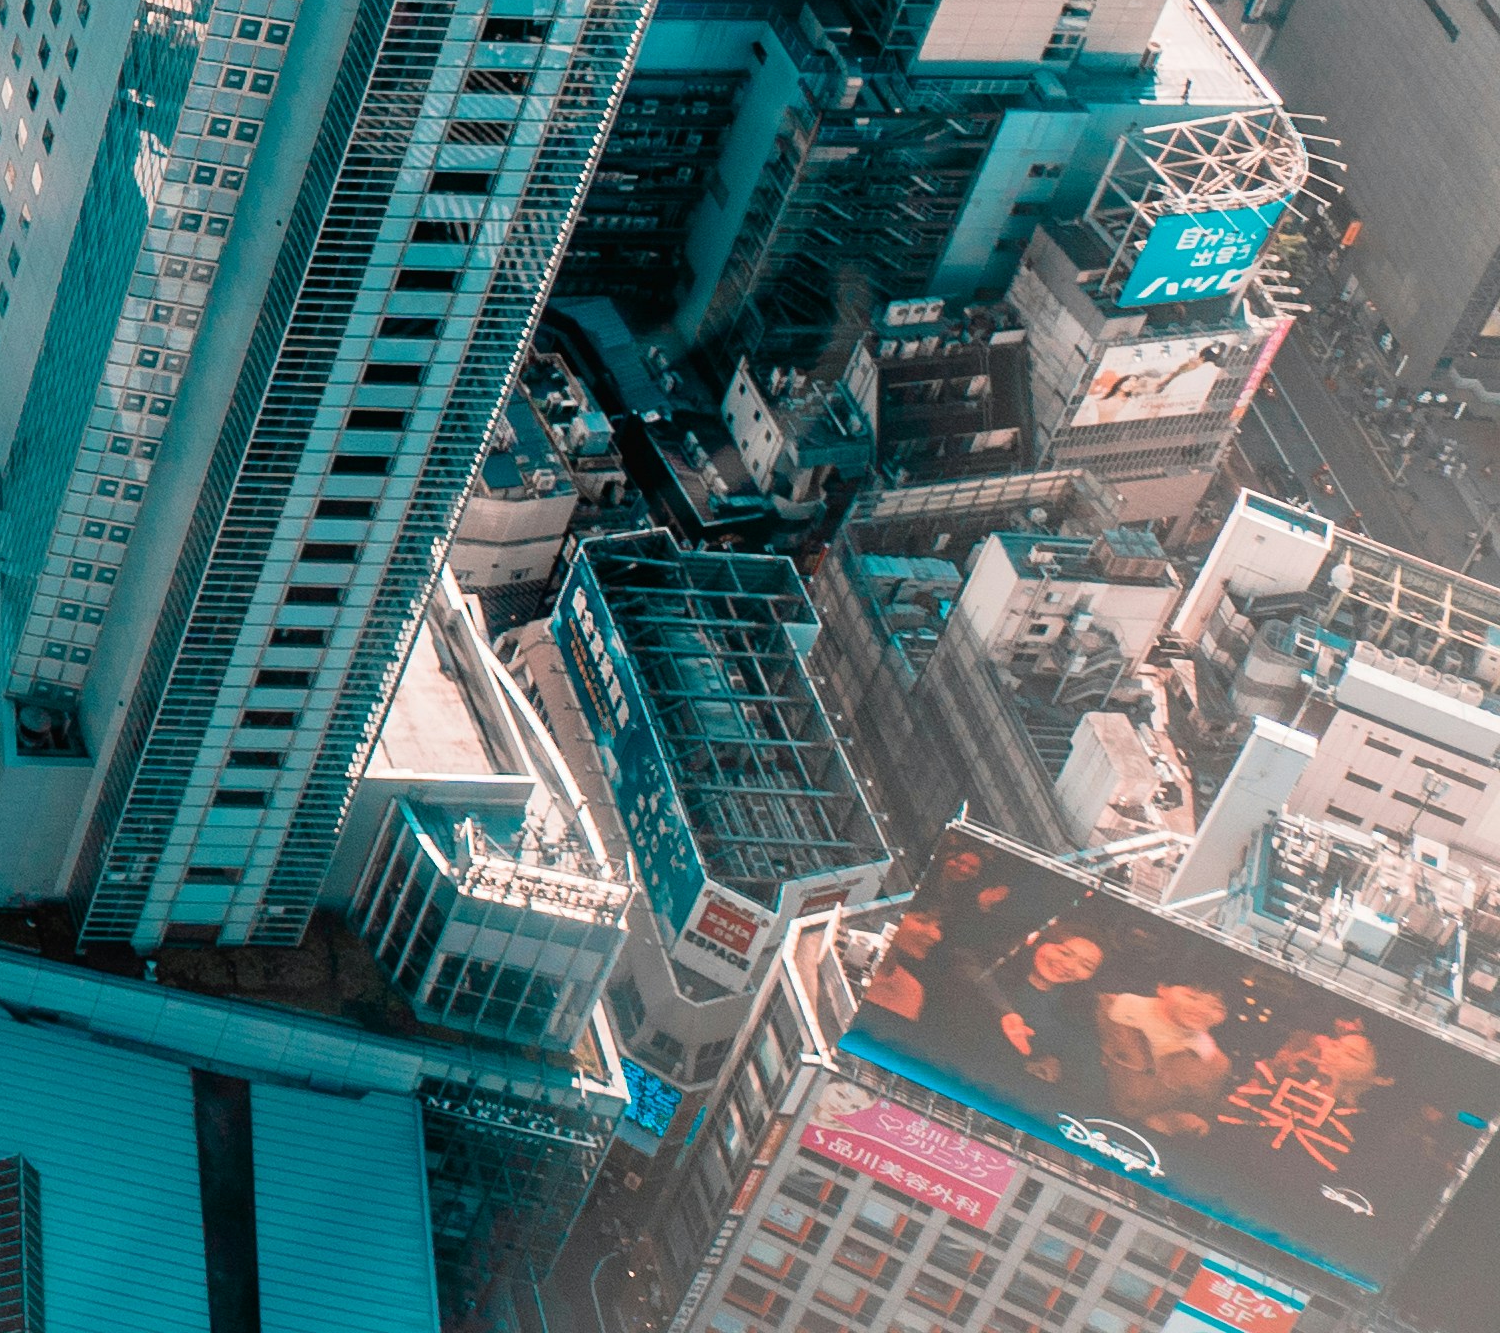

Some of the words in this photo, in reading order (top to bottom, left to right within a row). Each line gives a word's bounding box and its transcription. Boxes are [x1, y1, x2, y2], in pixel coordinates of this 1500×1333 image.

[684, 929, 752, 971] ESPACE
[828, 1135, 983, 1219] 品川美容外科
[898, 1133, 990, 1181] クリニック
